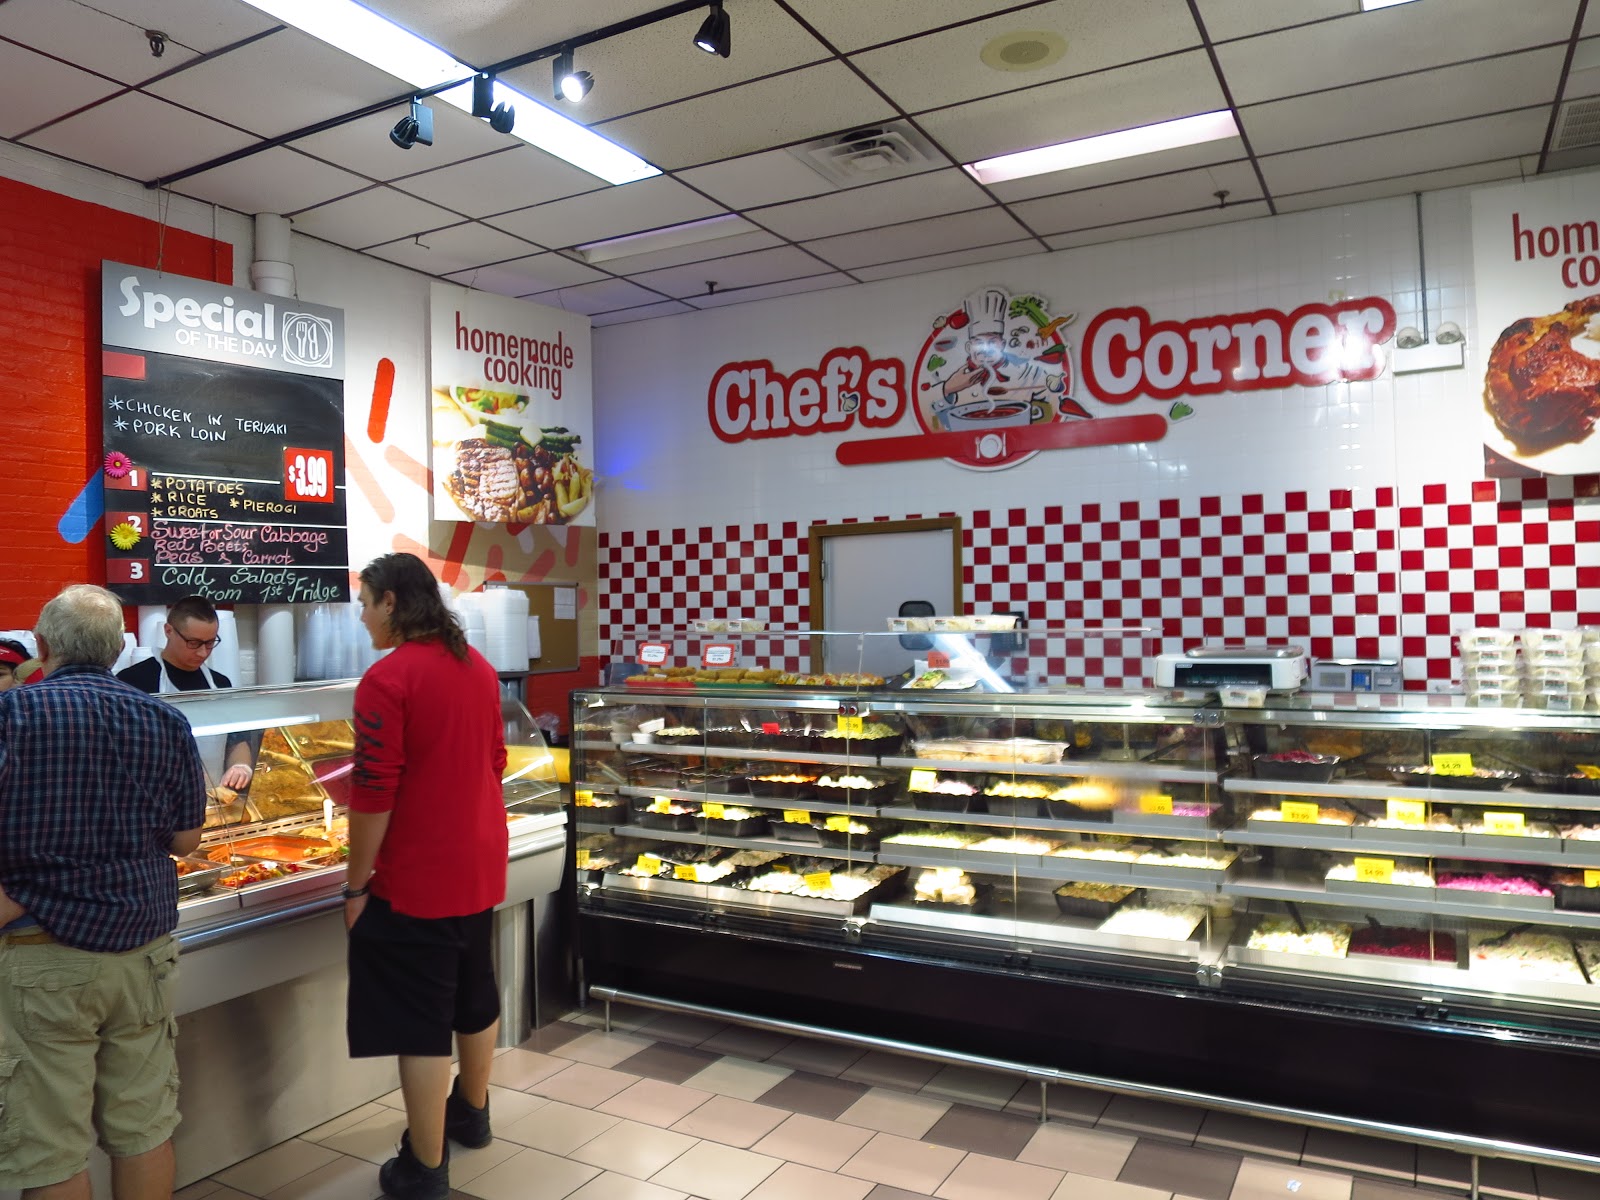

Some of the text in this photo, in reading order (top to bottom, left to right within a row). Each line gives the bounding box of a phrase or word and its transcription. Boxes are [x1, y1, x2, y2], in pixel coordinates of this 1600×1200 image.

[119, 276, 275, 341] Special
[175, 328, 277, 359] OF THE DAY
[455, 311, 573, 369] homemade
[484, 355, 562, 401] cooking
[713, 308, 1384, 436] Chef's Corner
[126, 399, 288, 435] CHICKEN IN TERIYAKI
[133, 419, 226, 441] PORK LOIN
[129, 469, 138, 487] 1
[166, 477, 245, 495] POTATOES
[288, 455, 327, 497] $3.99
[168, 491, 297, 514] RICE PIEROGI
[168, 505, 219, 519] GROATS
[127, 515, 142, 533] 2
[151, 520, 328, 552] Sweet or Sour Cabbage
[154, 538, 249, 552] Red Beets
[155, 549, 203, 564] Peas
[242, 548, 295, 565] Carrot
[130, 562, 143, 579] 3
[162, 567, 297, 585] Cold Salads
[190, 577, 340, 603] from 1st Fridge
